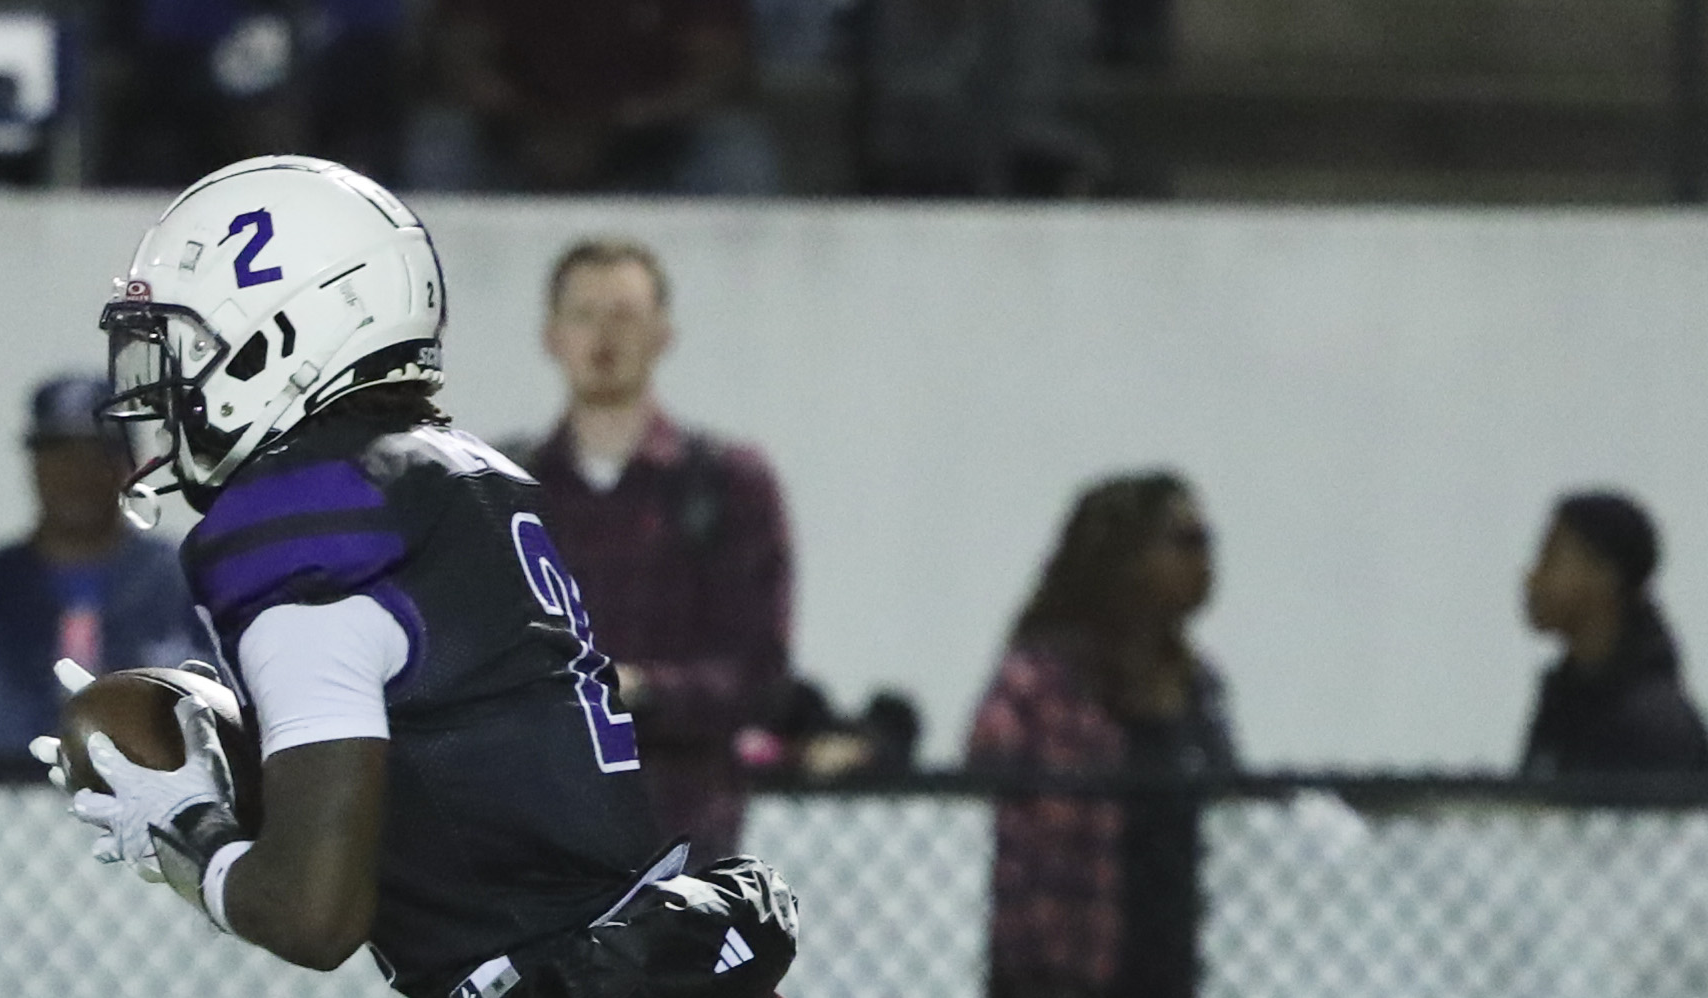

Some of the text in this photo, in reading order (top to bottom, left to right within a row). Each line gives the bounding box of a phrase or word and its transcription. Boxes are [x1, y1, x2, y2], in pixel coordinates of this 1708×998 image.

[229, 210, 283, 289] 2
[427, 281, 435, 308] 2
[511, 511, 641, 774] 2
